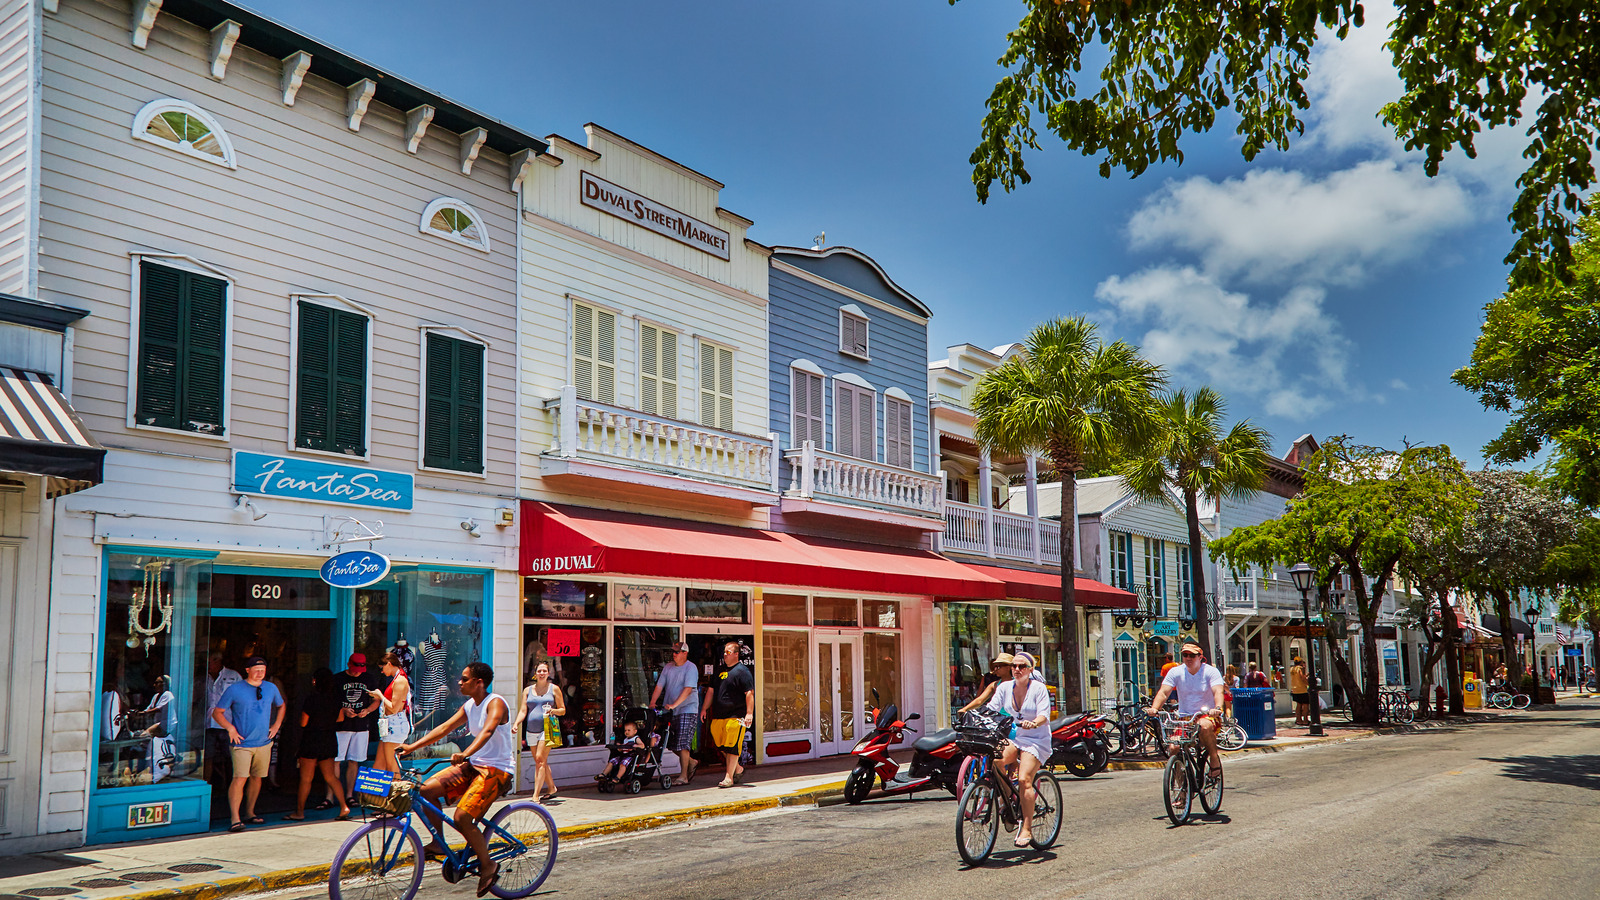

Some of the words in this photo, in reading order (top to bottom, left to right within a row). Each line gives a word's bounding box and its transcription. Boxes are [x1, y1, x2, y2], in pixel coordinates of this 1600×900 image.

[677, 217, 727, 251] MARKET
[254, 459, 402, 502] FantaSea
[532, 557, 552, 572] 618
[554, 554, 596, 571] DUVAL
[251, 584, 282, 599] 620
[343, 682, 367, 690] UNITED
[138, 807, 163, 824] 620
